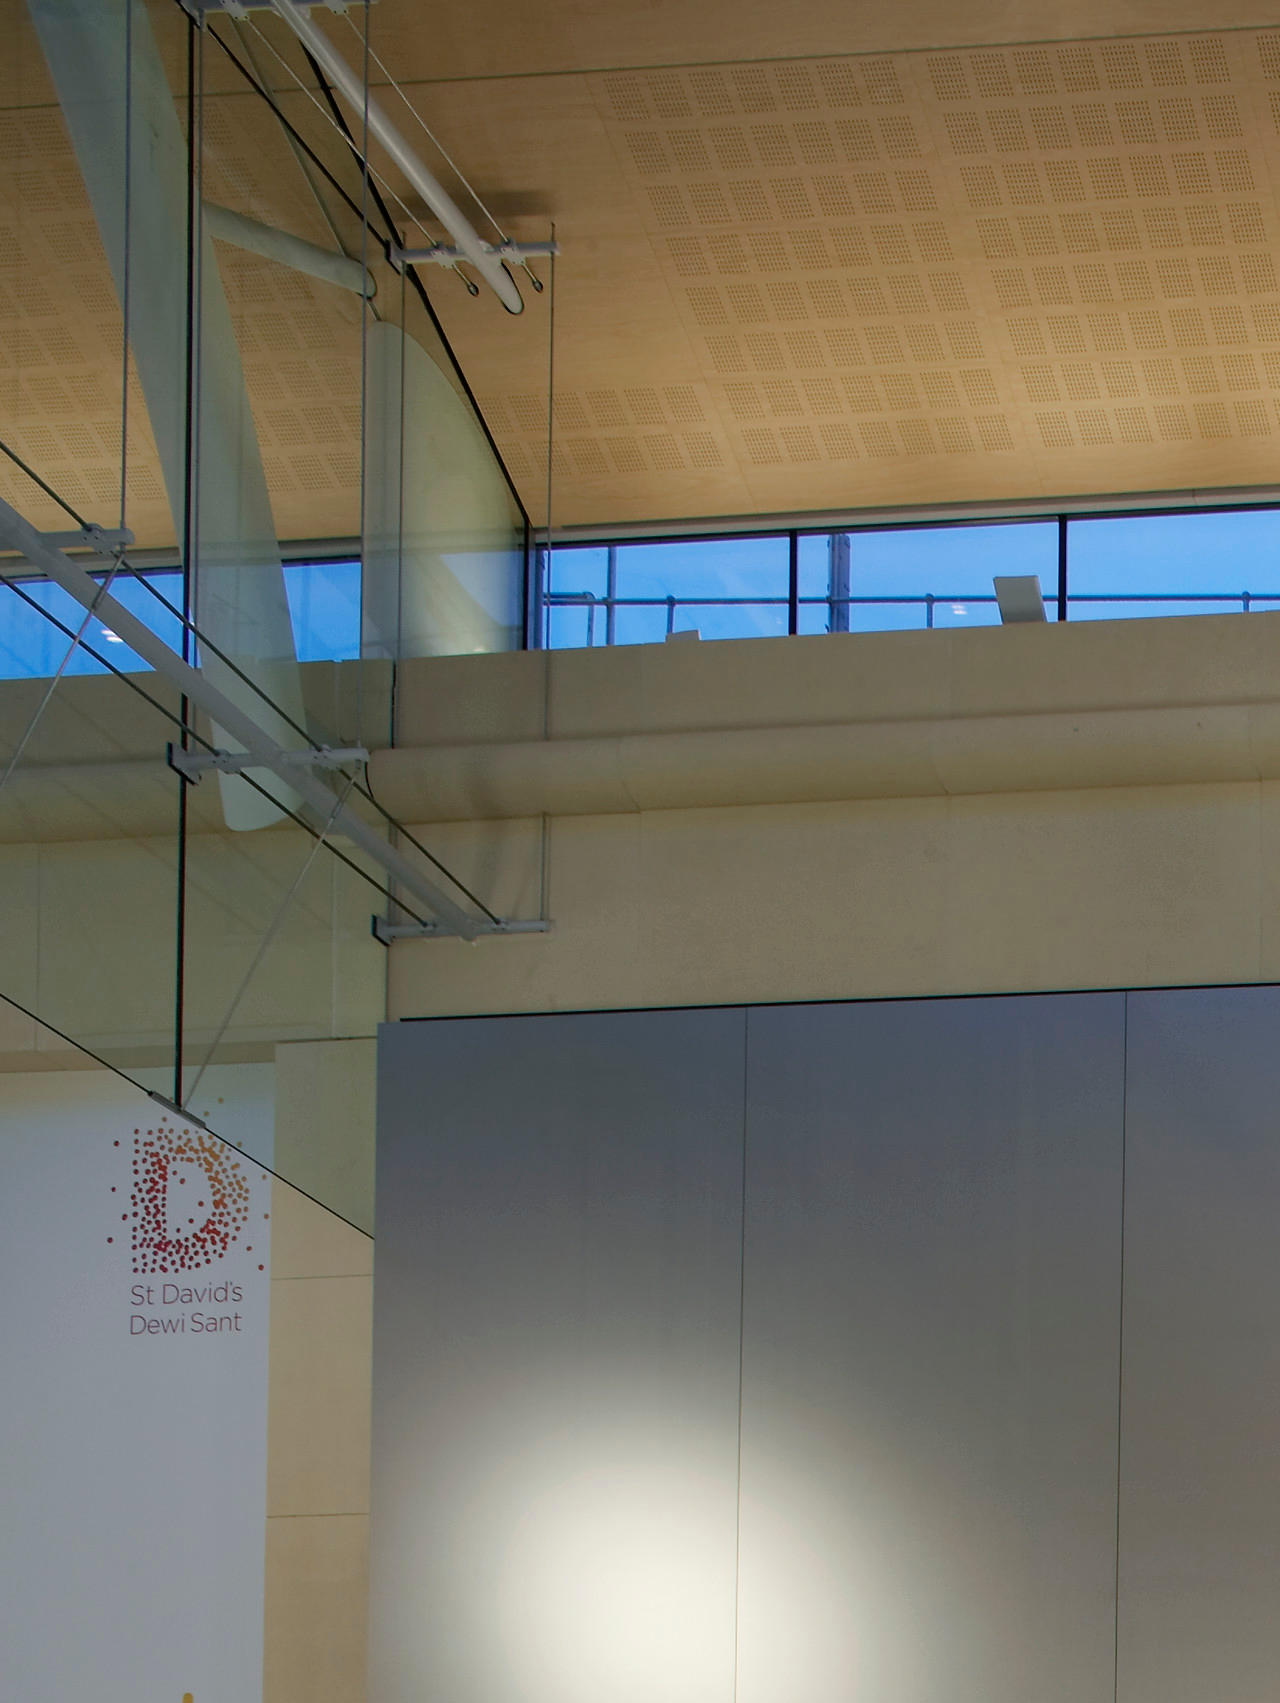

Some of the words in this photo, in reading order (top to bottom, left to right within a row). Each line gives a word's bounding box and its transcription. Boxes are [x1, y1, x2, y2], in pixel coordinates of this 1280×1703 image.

[130, 1283, 155, 1306] St
[162, 1280, 243, 1305] David's
[129, 1313, 186, 1336] Dewi
[190, 1311, 243, 1334] Sant
